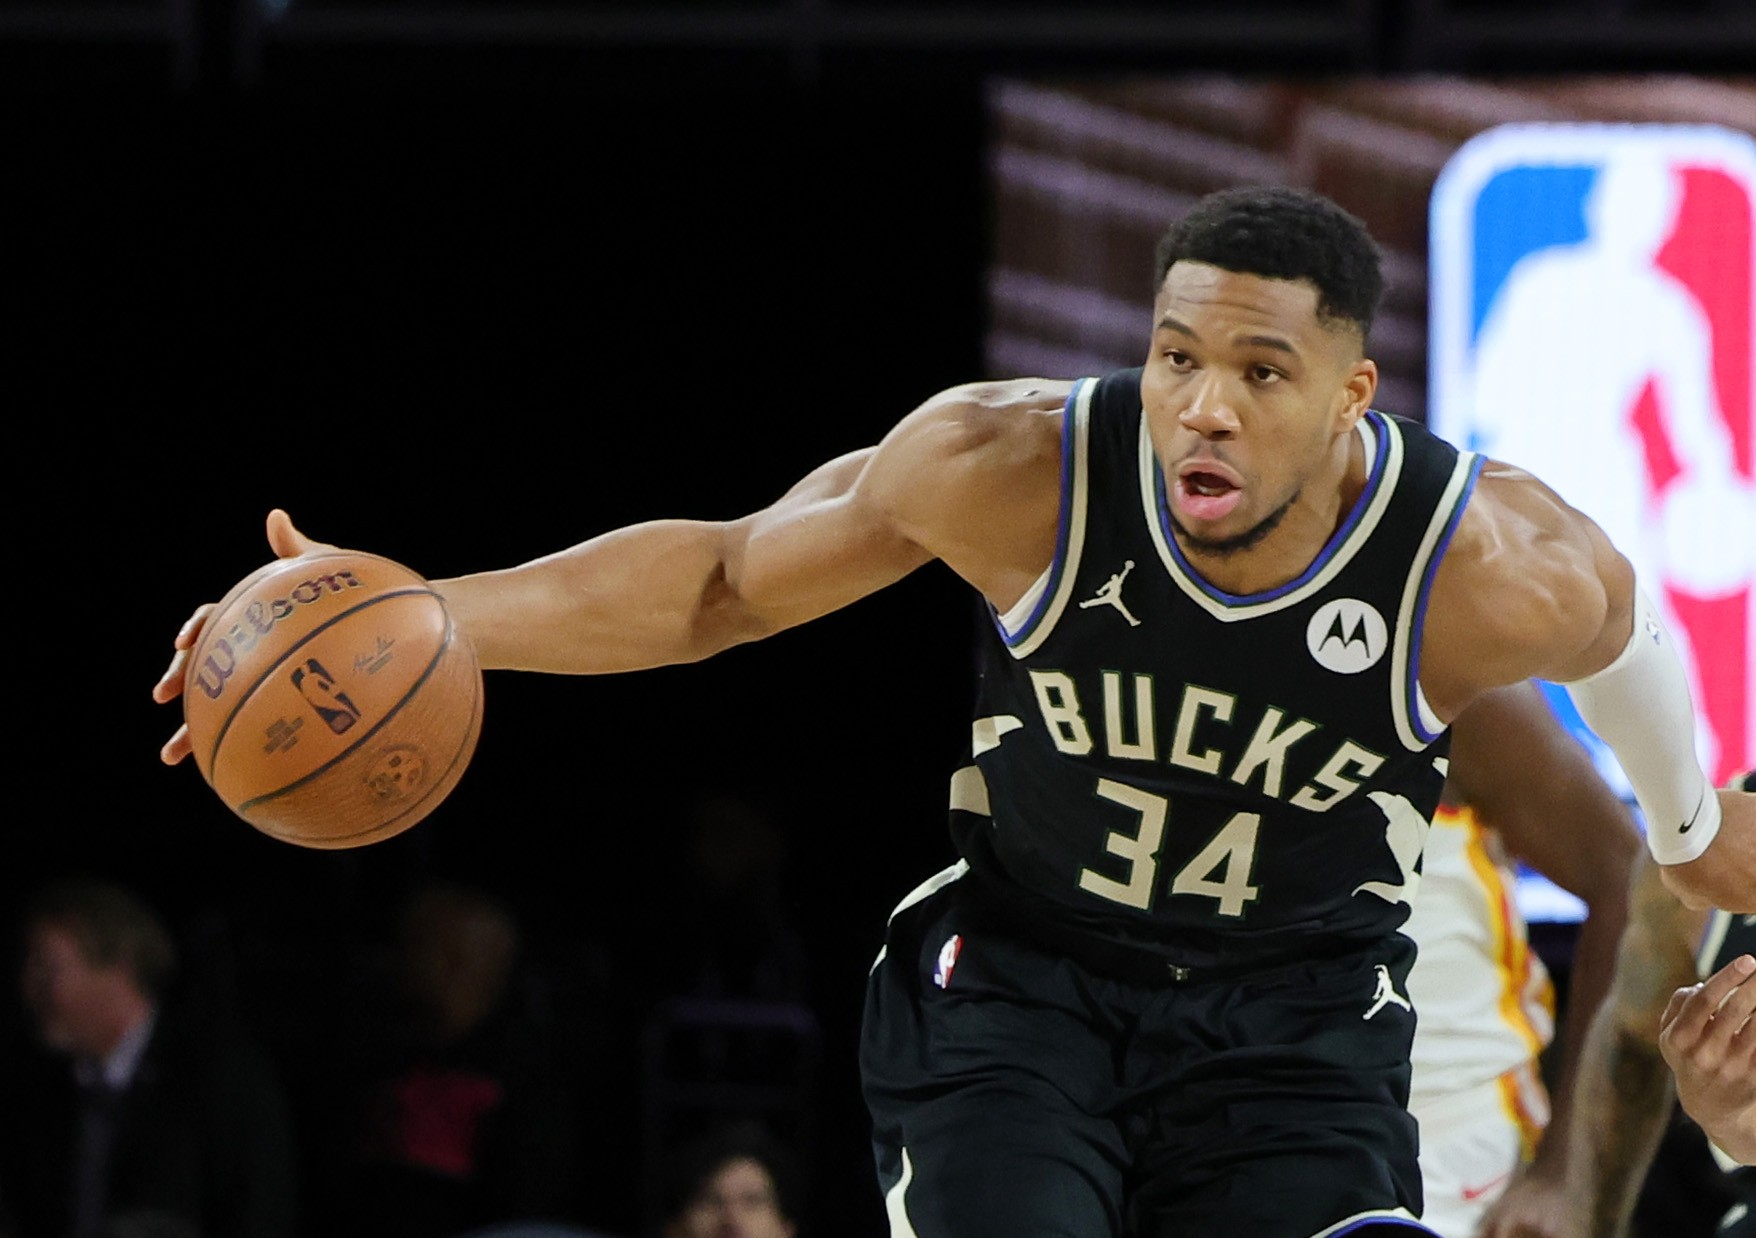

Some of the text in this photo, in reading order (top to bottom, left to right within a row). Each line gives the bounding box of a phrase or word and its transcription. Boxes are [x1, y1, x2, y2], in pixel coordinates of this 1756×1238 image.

[196, 571, 365, 699] Wilson
[1029, 669, 1389, 812] BUCKS
[1078, 778, 1262, 918] 34
